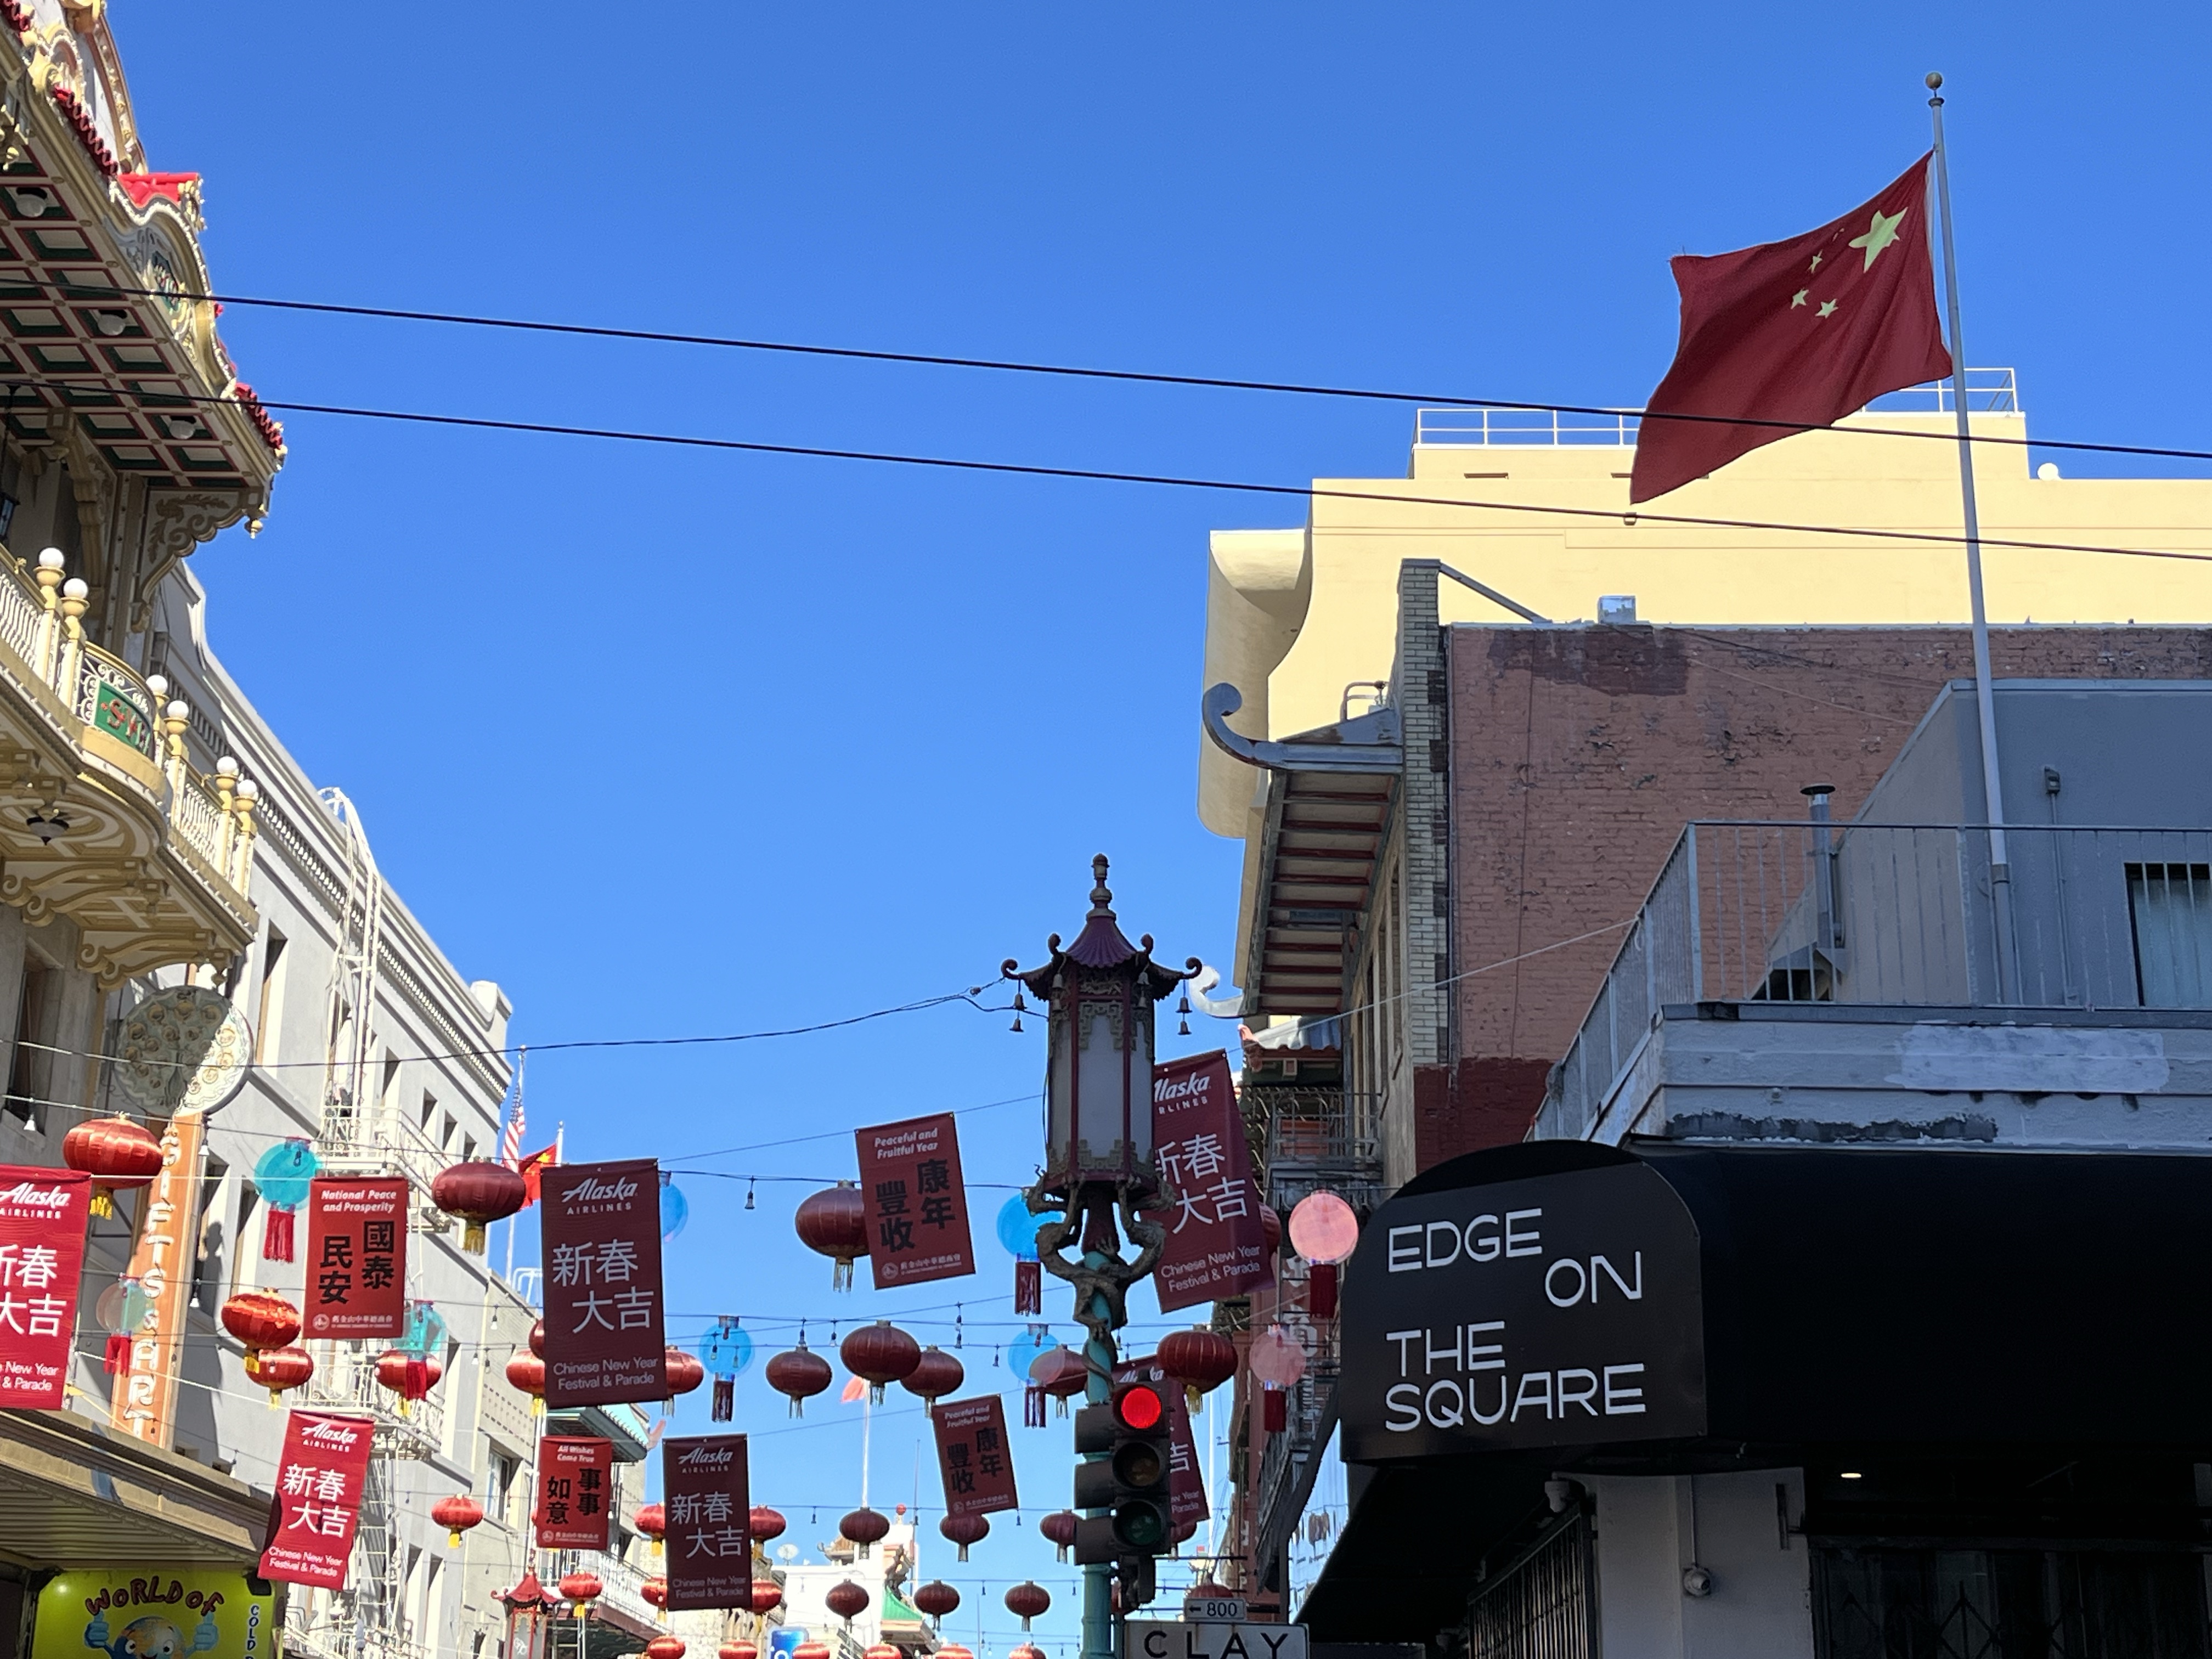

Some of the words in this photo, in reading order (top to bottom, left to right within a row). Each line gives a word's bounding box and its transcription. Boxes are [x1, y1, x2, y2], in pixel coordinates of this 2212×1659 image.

[874, 1131, 917, 1147] Peaceful
[918, 1127, 938, 1140] and
[877, 1143, 915, 1160] Fruitful
[916, 1142, 938, 1153] Year
[0, 1182, 71, 1209] Alaska
[321, 1189, 366, 1200] National
[368, 1189, 397, 1200] Peace
[561, 1176, 638, 1203] Alaska
[917, 1158, 956, 1230] 康年
[1172, 1176, 1248, 1234] 大吉
[323, 1201, 343, 1212] and
[343, 1202, 396, 1214] Prosperity
[567, 1202, 632, 1215] AIRLINES
[875, 1180, 915, 1253] 豐收
[362, 1220, 395, 1289] 國泰
[1387, 1207, 1543, 1273] EDGE
[318, 1235, 353, 1305] 民安
[552, 1238, 639, 1287] 新春
[1161, 1259, 1206, 1278] Chinese
[1207, 1251, 1235, 1266] New
[1237, 1245, 1261, 1258] Year
[1168, 1270, 1210, 1293] Festival
[1211, 1268, 1221, 1280] &
[1223, 1260, 1261, 1277] Parade
[1545, 1251, 1643, 1308] ON
[572, 1285, 654, 1334] 大吉
[553, 1362, 600, 1375] Chinese
[602, 1358, 630, 1372] New
[633, 1356, 658, 1369] Year
[1386, 1321, 1506, 1378] THE
[2, 1376, 12, 1389] &
[14, 1376, 53, 1391] Parade
[4, 1361, 33, 1374] New
[35, 1363, 59, 1376] Year
[558, 1375, 600, 1390] Festival
[603, 1375, 612, 1387] &
[615, 1372, 655, 1386] Parade
[1386, 1363, 1646, 1432] SQUARE
[302, 1421, 358, 1444] Alaska
[303, 1439, 350, 1453] AIRLINES
[678, 1447, 733, 1465] Alaska
[682, 1464, 729, 1474] AIRLINES
[283, 1463, 346, 1502] 新春
[576, 1468, 602, 1516] 事事
[545, 1475, 571, 1525] 如意
[671, 1491, 733, 1525] 新春
[287, 1501, 351, 1538] 大吉
[269, 1546, 302, 1560] Chinese
[303, 1551, 323, 1564] New
[325, 1555, 343, 1566] Year
[685, 1525, 744, 1560] 大吉
[269, 1558, 300, 1571] Festival
[301, 1562, 308, 1572] &
[309, 1564, 337, 1577] Parade
[1206, 1602, 1238, 1617] 800
[247, 1605, 260, 1651] COLD
[1144, 1630, 1289, 1659] CLAY
